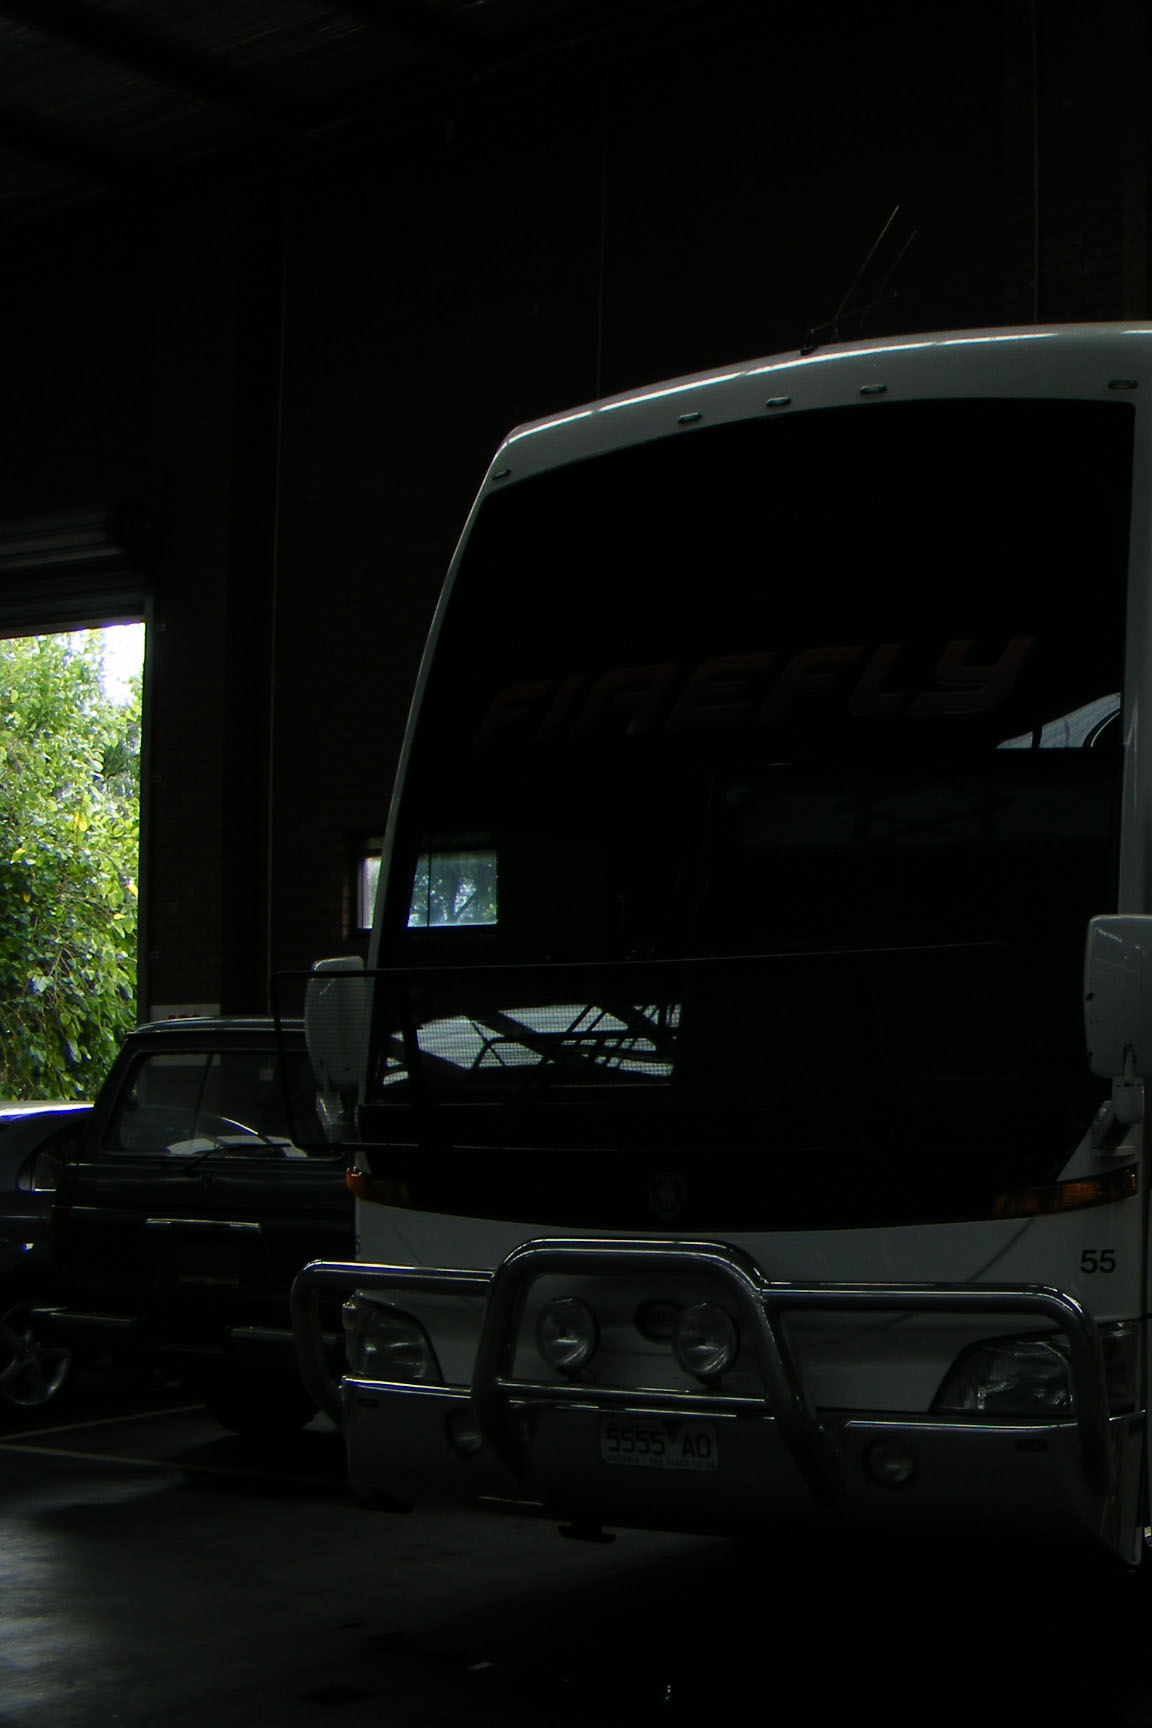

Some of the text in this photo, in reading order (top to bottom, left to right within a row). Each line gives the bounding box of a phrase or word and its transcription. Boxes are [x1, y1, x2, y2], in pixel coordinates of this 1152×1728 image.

[465, 635, 1039, 753] FIREFLY
[1080, 1249, 1116, 1274] 55
[605, 1426, 666, 1456] 5555
